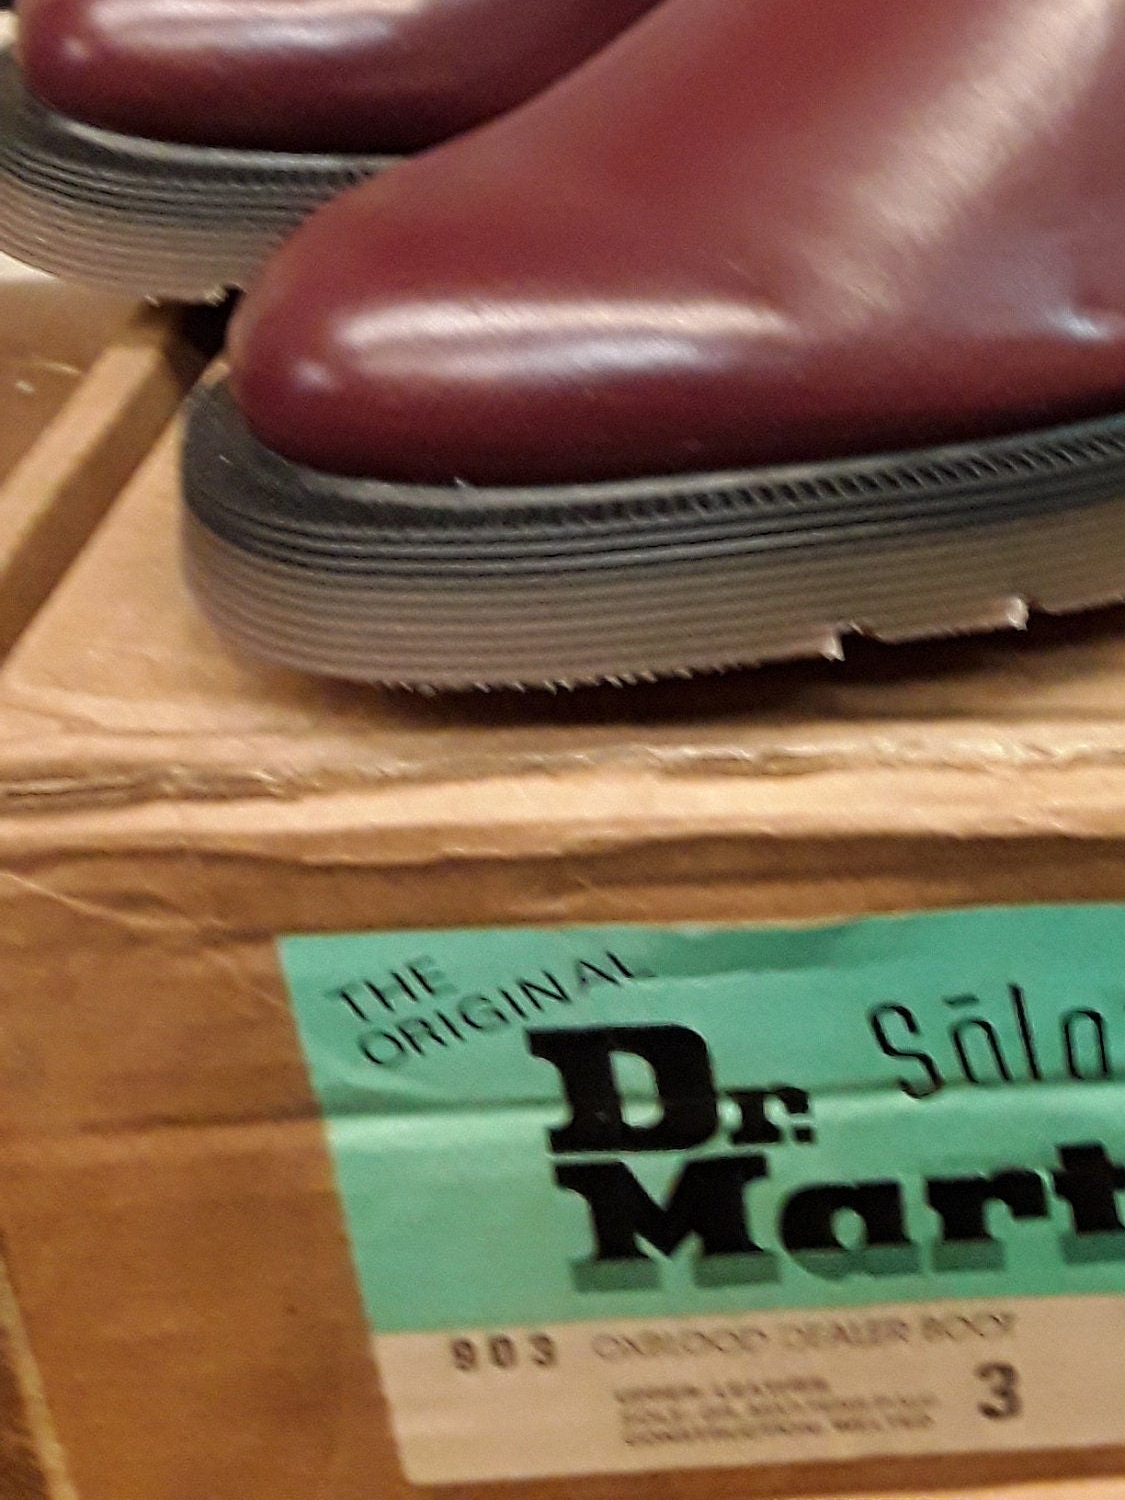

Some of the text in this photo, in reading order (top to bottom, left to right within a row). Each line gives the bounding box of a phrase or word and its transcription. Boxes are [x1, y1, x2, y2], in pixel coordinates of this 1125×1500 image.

[328, 955, 457, 1023] THE
[358, 951, 655, 1069] ORIGINAL
[523, 1022, 815, 1155] Dr.
[974, 1360, 1024, 1420] 3
